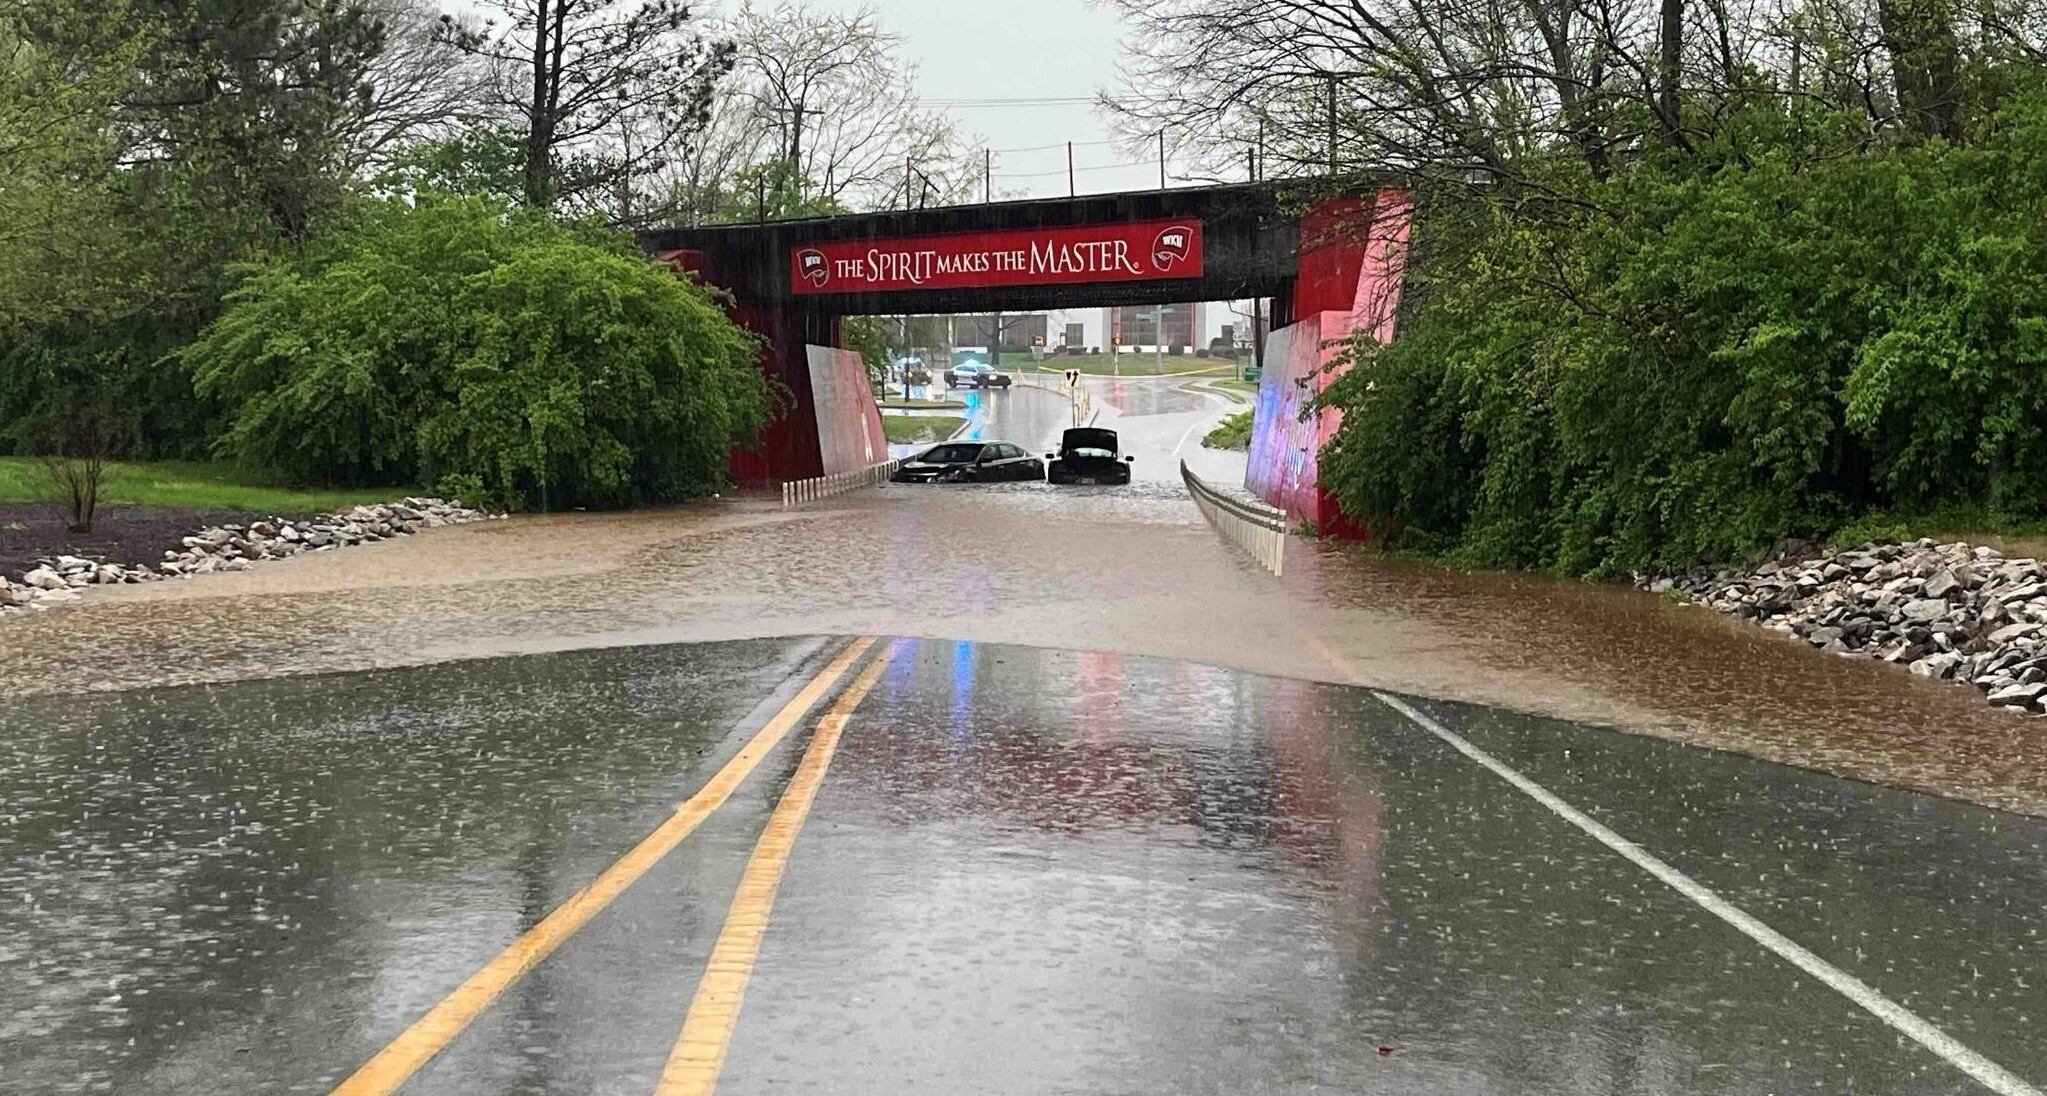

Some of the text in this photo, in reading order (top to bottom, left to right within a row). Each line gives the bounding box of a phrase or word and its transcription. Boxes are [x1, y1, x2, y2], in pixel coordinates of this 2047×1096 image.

[1162, 235, 1183, 248] WKU
[835, 260, 864, 278] THE
[866, 249, 936, 284] SPIRIT
[936, 252, 990, 274] MAKES
[992, 250, 1026, 271] THE
